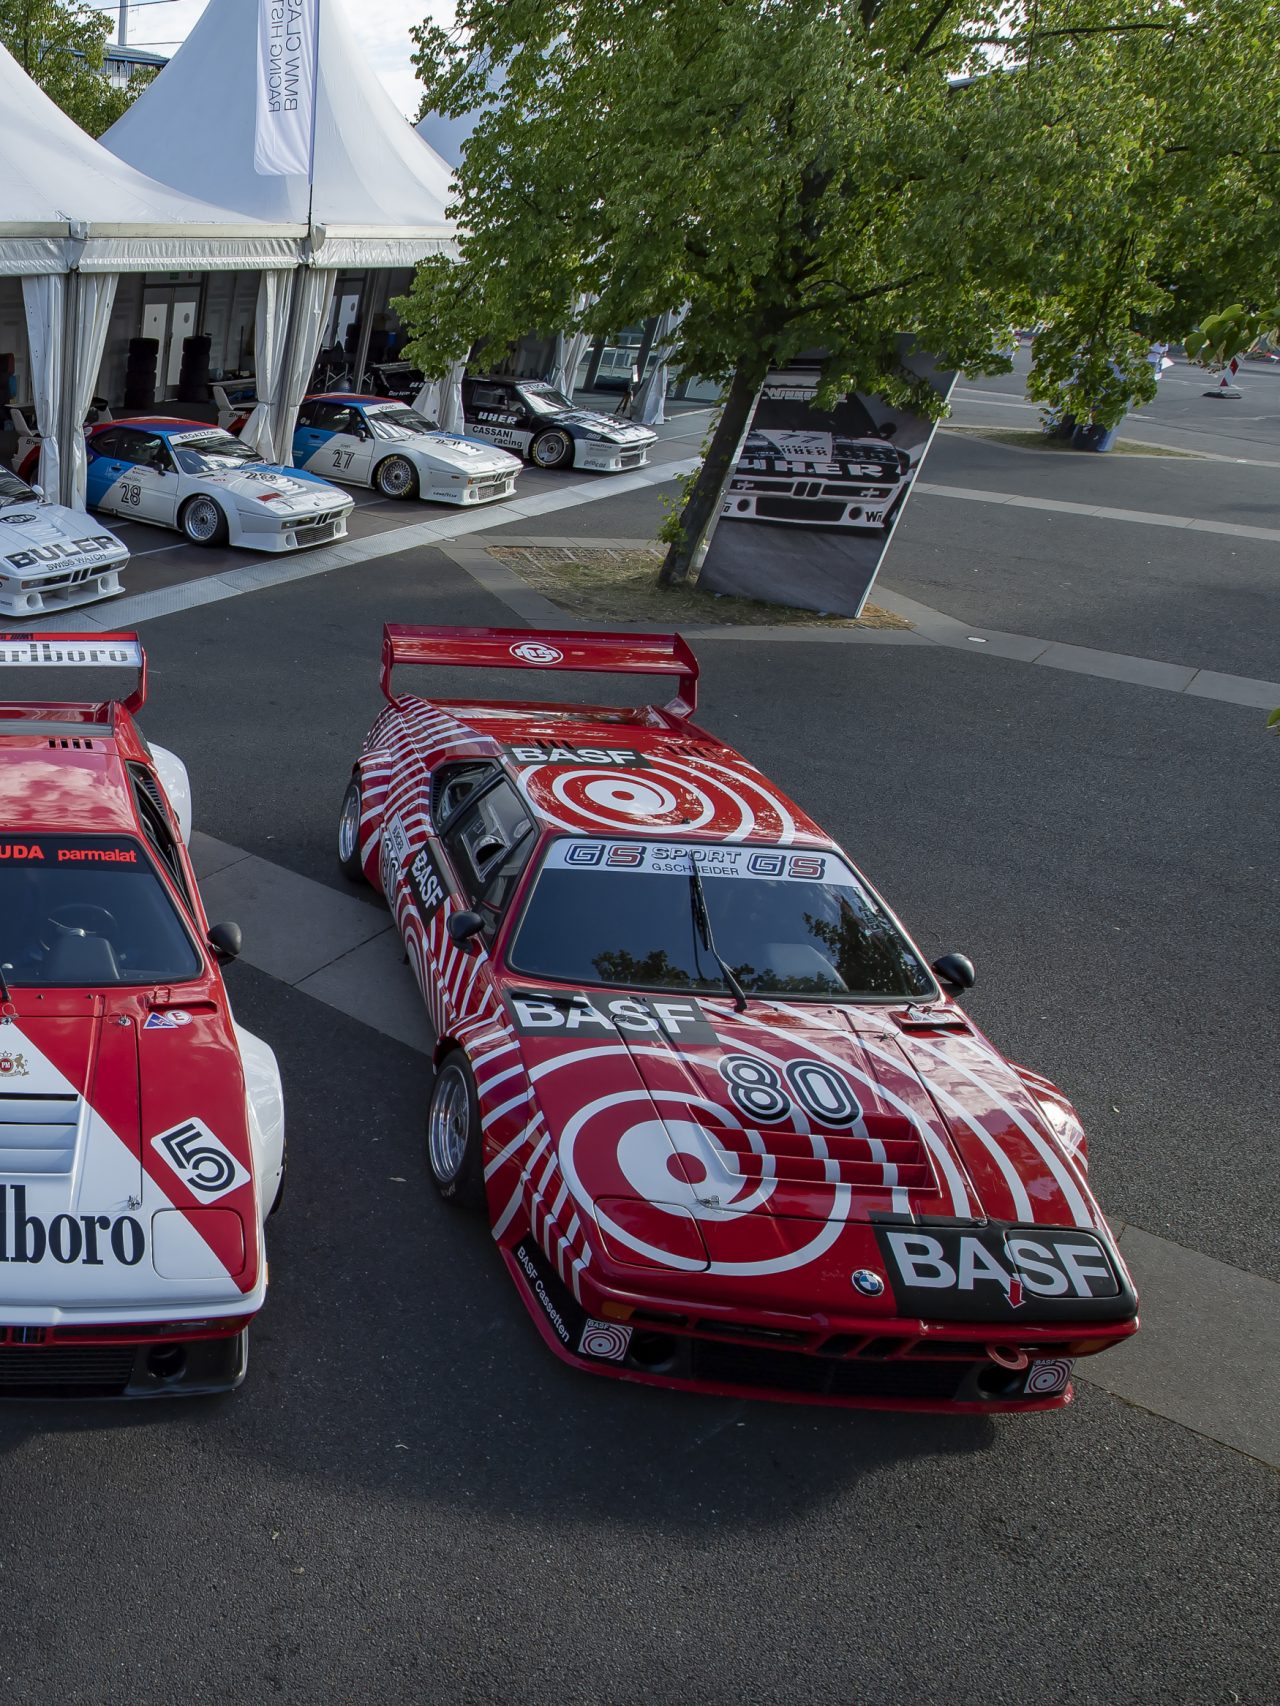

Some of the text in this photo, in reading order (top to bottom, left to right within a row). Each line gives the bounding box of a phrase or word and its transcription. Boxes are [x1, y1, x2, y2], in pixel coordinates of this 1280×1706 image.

[472, 425, 513, 438] CASSANI
[493, 437, 523, 448] racing
[332, 449, 355, 469] 27
[119, 482, 141, 506] 28
[4, 536, 121, 569] BULER
[47, 553, 106, 571] SWISS WATCH
[512, 747, 637, 764] BASF
[57, 848, 137, 863] parmalat
[651, 847, 742, 864] SPORT
[411, 849, 444, 909] BASF
[512, 993, 700, 1034] BASF
[718, 1053, 864, 1129] 80
[160, 1122, 237, 1194] 5
[886, 1231, 1111, 1297] BASF
[517, 1246, 570, 1342] BASF Cassetten
[587, 1320, 610, 1330] BASF
